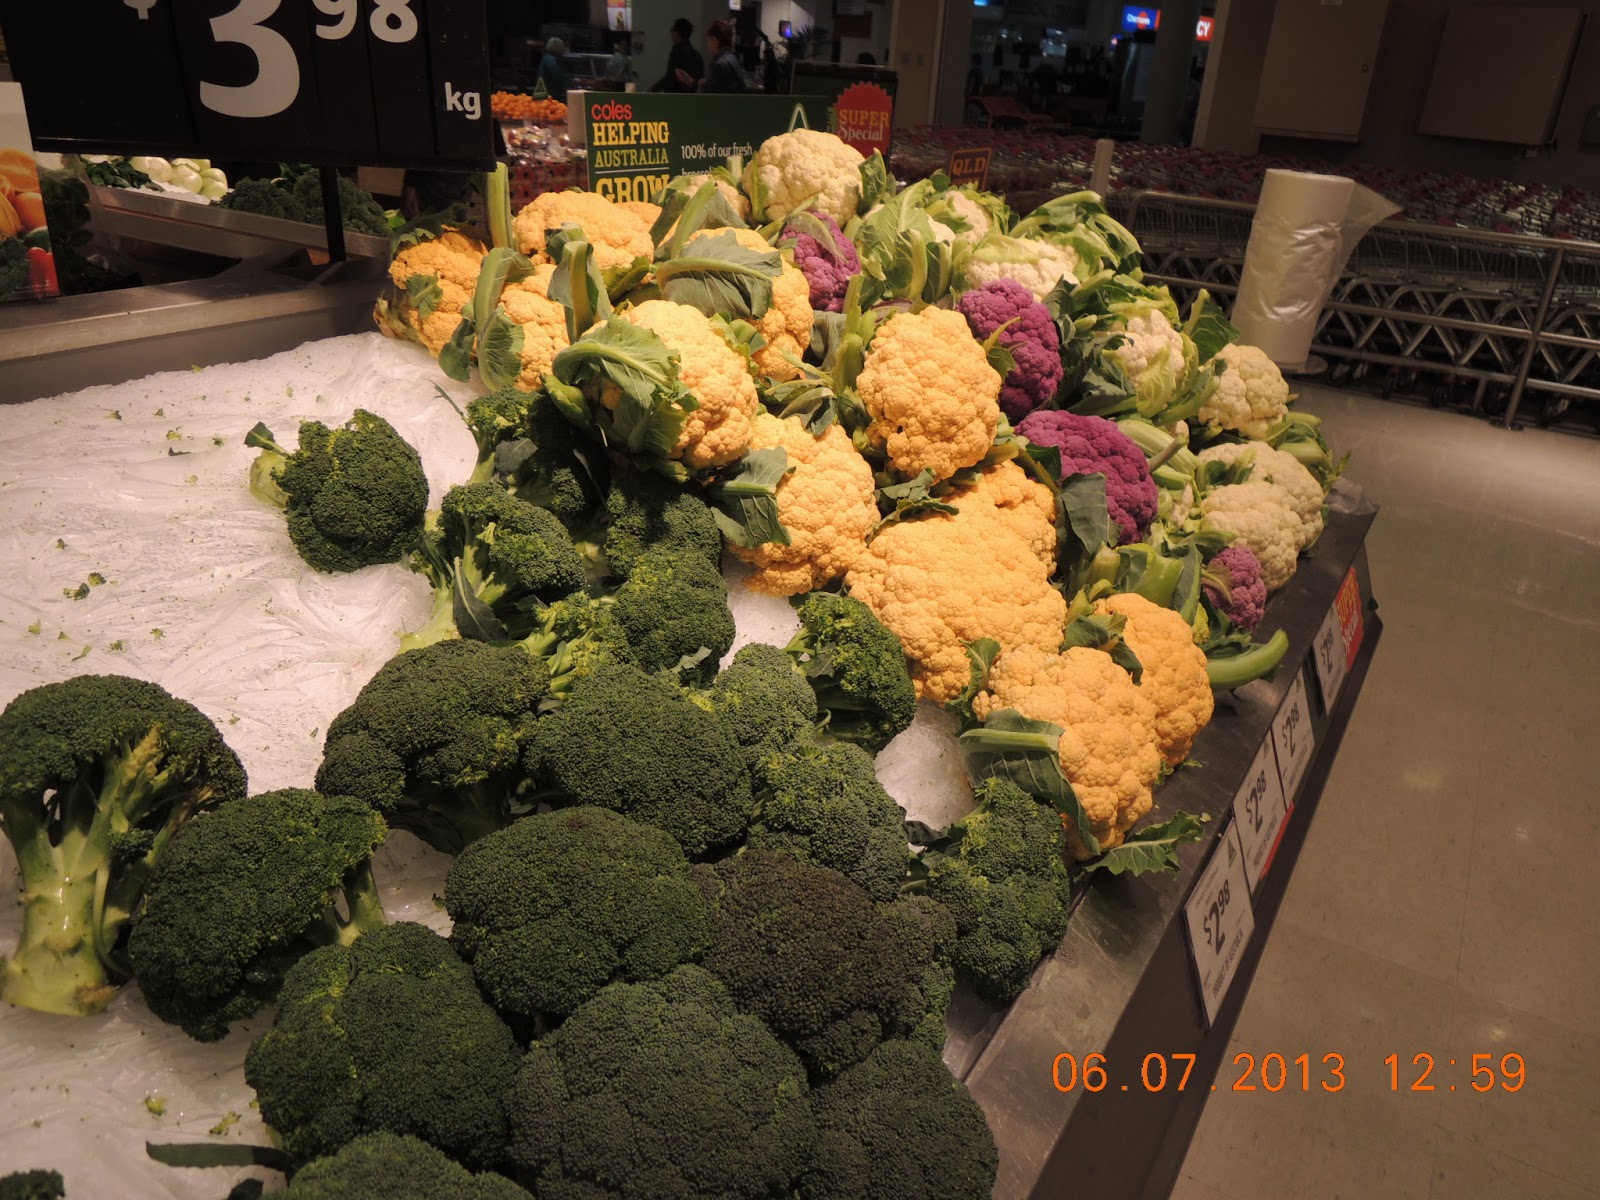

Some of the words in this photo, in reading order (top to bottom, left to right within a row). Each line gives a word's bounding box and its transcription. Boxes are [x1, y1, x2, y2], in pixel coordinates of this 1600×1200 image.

[444, 81, 482, 120] kg
[591, 99, 633, 120] coles
[838, 109, 889, 127] SUPER
[592, 121, 669, 146] HELPING
[837, 123, 884, 142] Special
[595, 147, 669, 168] AUSTRALIA
[681, 144, 707, 160] 100%
[708, 143, 717, 158] of
[718, 146, 731, 158] our
[953, 157, 986, 176] QLD
